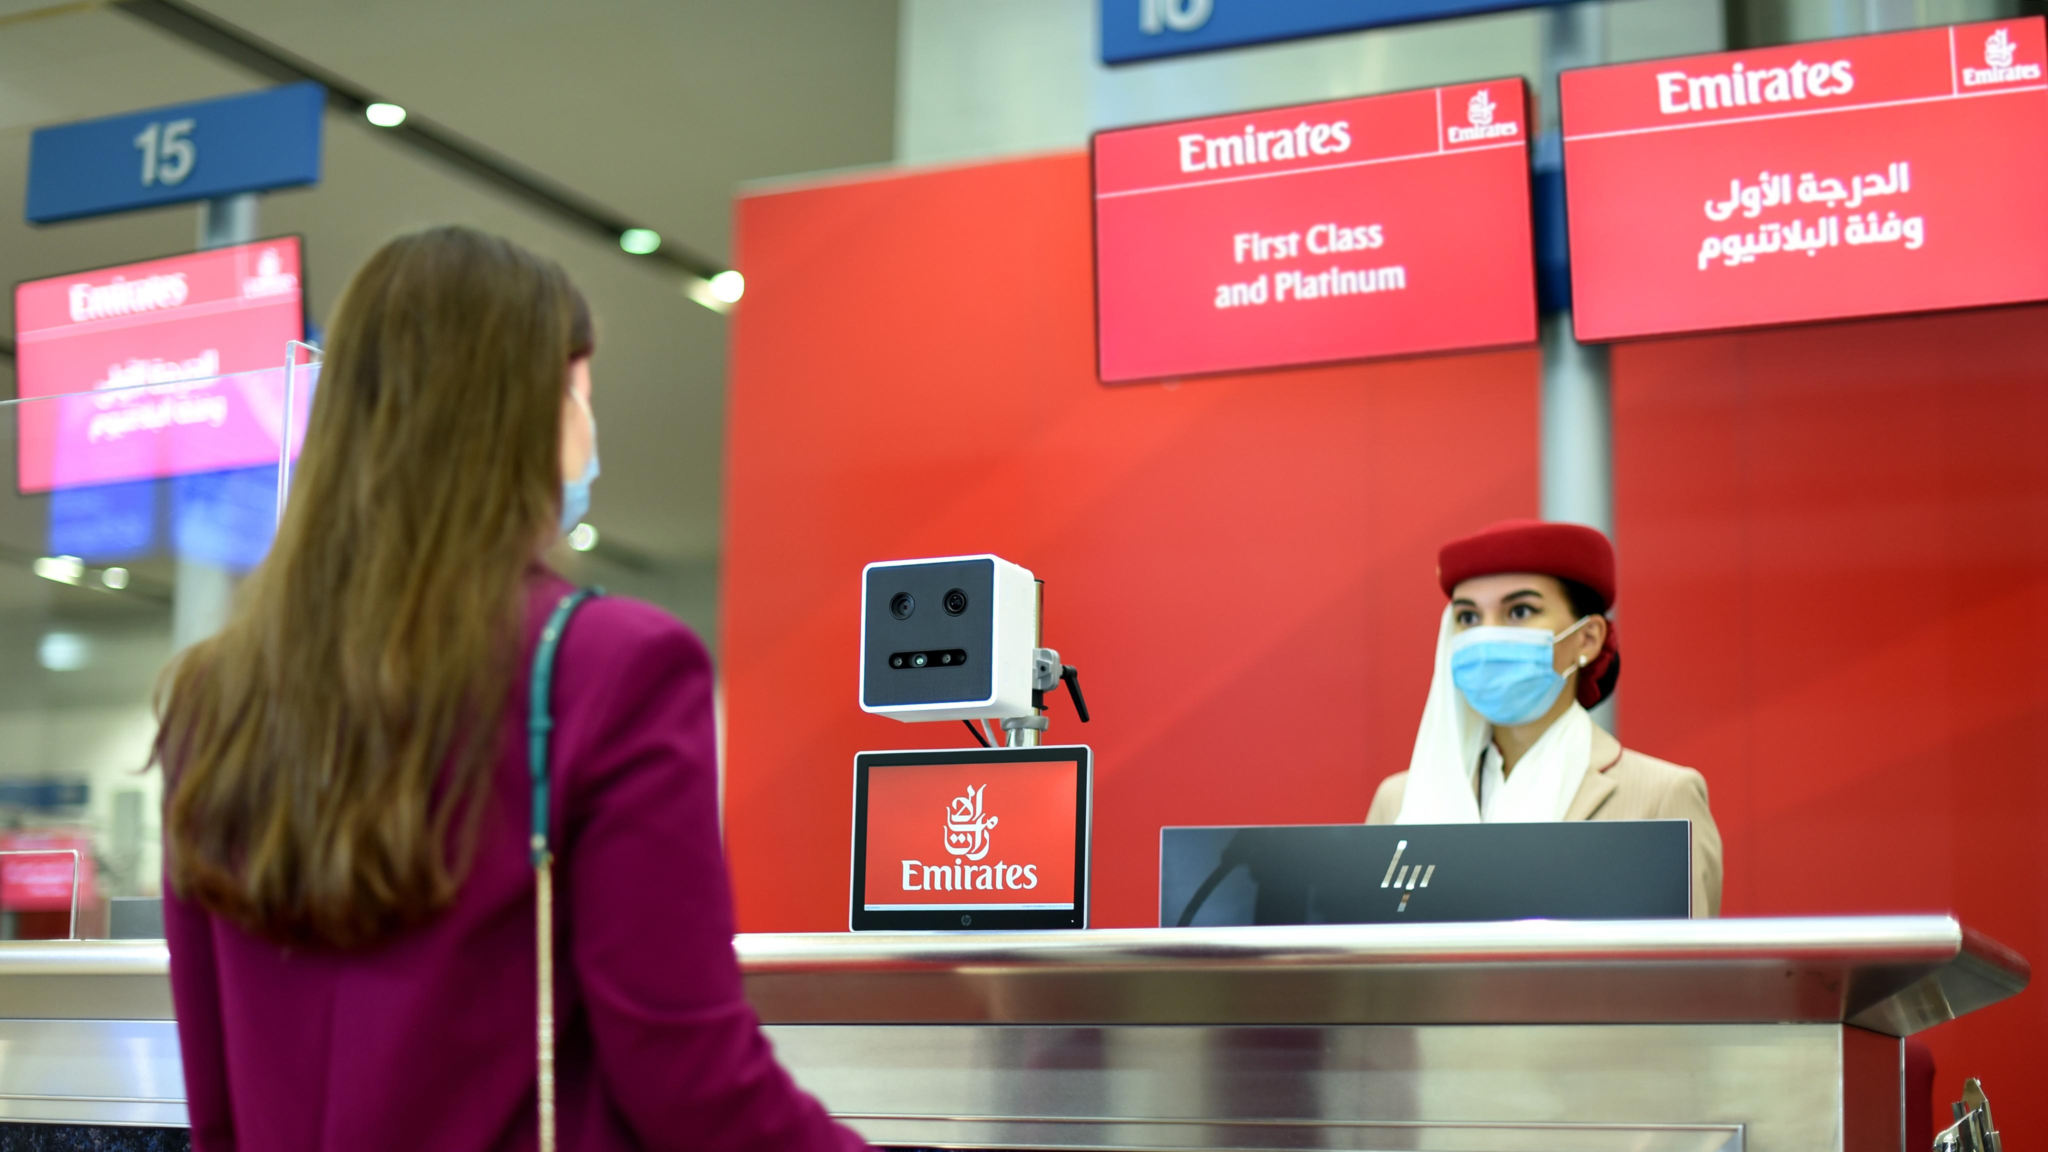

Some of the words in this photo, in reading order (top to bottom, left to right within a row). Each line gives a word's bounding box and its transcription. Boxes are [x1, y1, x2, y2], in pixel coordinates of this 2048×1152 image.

[1656, 59, 1854, 114] Emirates
[1962, 64, 2041, 86] Emirates
[133, 118, 197, 187] 15
[1178, 120, 1352, 173] Emirates
[1448, 121, 1518, 143] Emirates
[1704, 171, 1791, 222] الأولى
[1797, 162, 1910, 208] الدرجة
[1233, 231, 1300, 264] First
[1306, 223, 1384, 255] Class
[1698, 216, 1839, 270] البلاتنيوم
[1845, 211, 1924, 249] وفئة
[1214, 274, 1268, 309] and
[1274, 265, 1406, 302] Platinum
[901, 858, 1038, 892] Emirates
